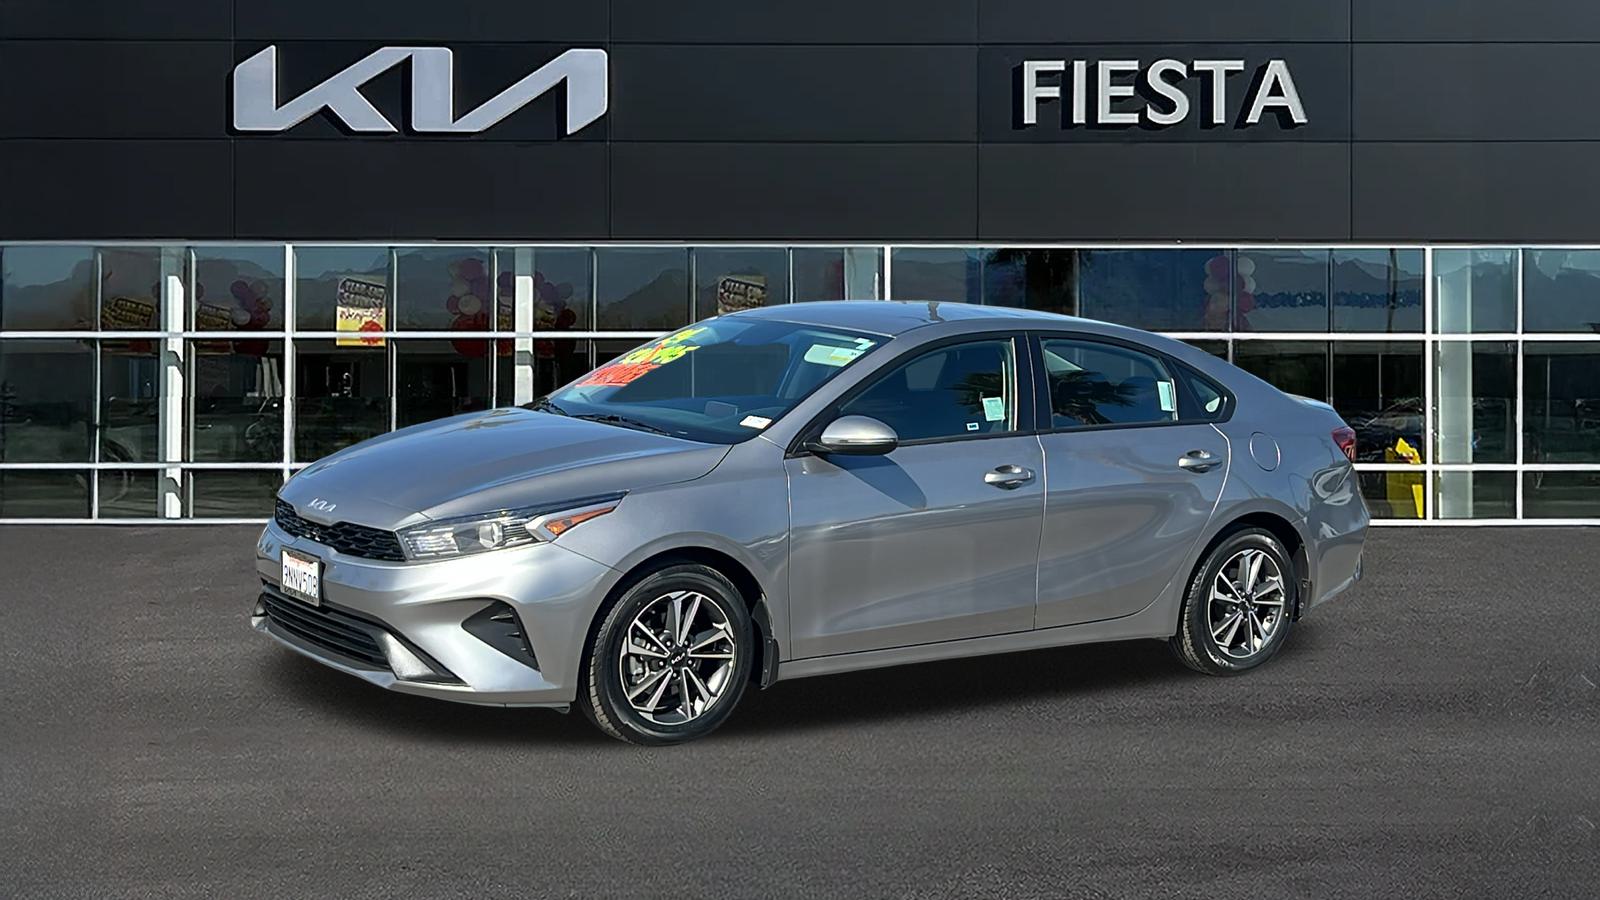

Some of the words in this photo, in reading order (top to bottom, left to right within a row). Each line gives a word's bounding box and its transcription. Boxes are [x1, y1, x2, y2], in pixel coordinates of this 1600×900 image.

[233, 45, 608, 135] KIA
[1022, 59, 1308, 125] FIESTA
[307, 498, 336, 512] KIA
